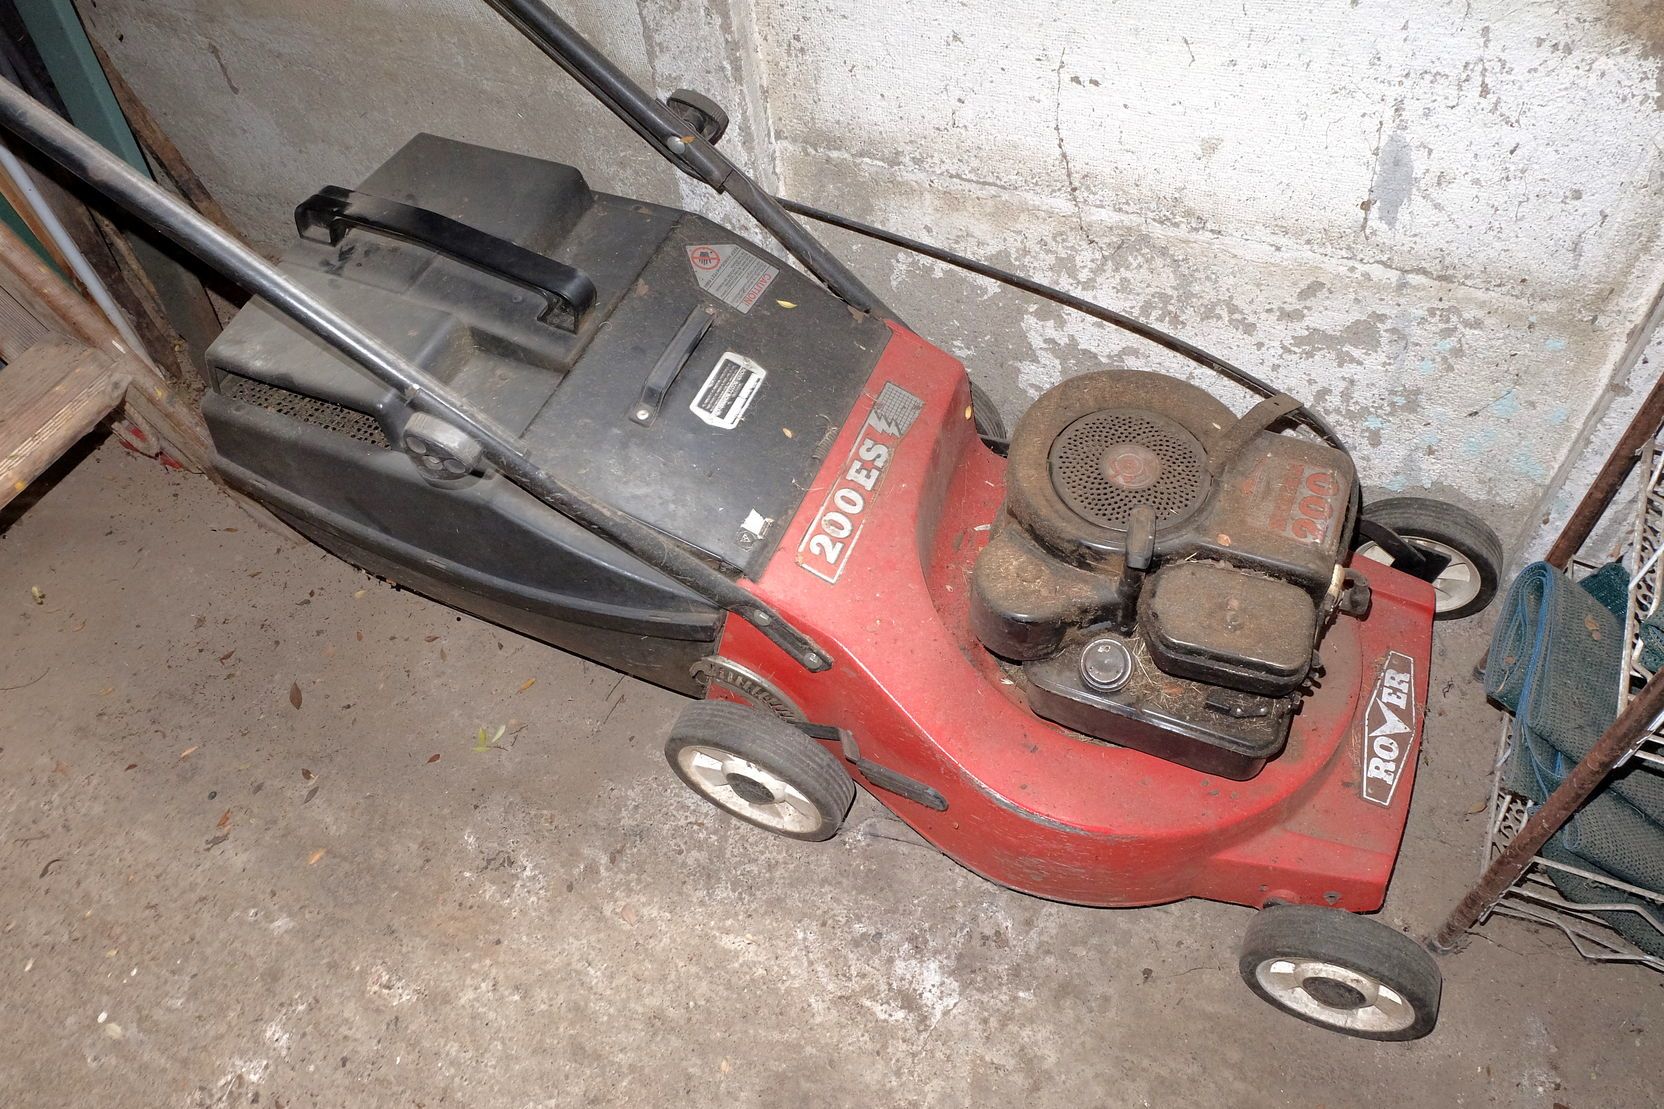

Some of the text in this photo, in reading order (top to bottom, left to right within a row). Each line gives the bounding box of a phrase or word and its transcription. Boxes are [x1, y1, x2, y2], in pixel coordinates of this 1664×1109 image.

[809, 438, 890, 565] 200 ES
[1291, 472, 1340, 544] 200
[1367, 668, 1412, 785] ROVER
